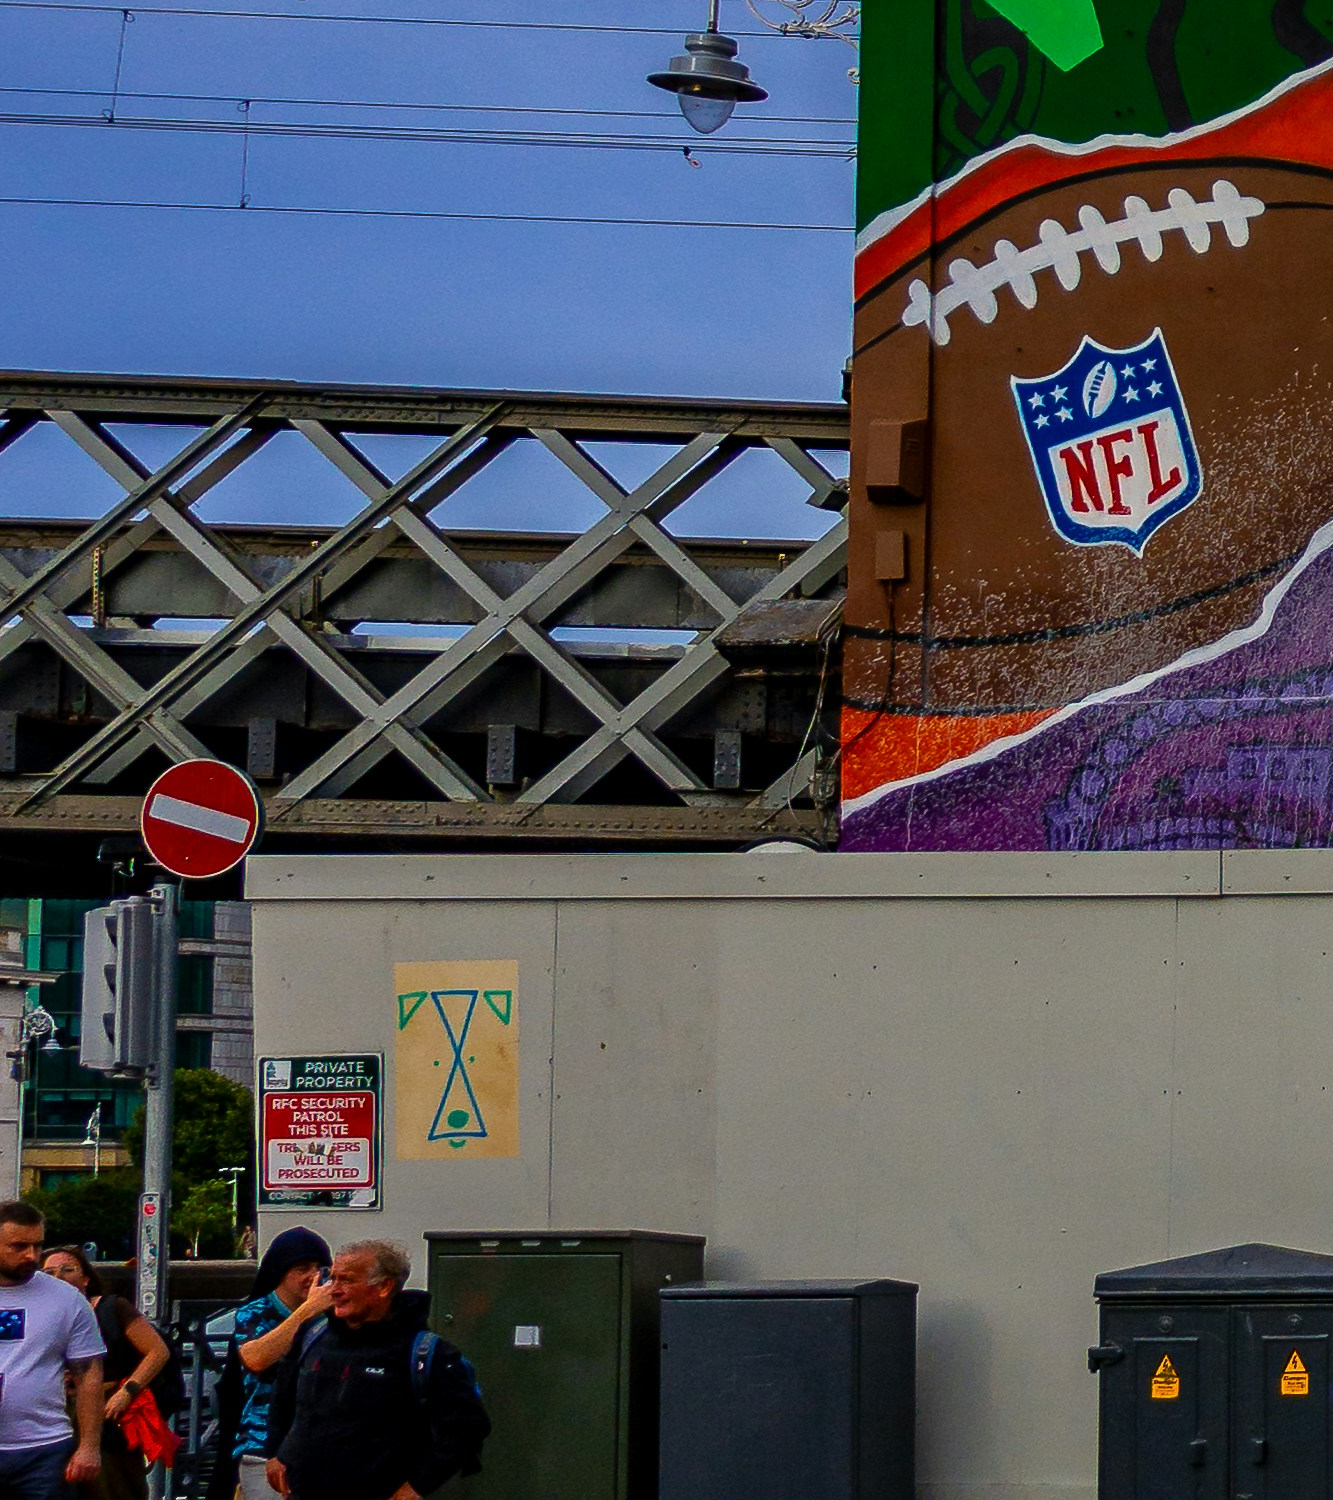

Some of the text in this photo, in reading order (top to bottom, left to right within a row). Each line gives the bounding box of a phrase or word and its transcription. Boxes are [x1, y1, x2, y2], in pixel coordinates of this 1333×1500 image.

[1059, 420, 1182, 518] NFL
[304, 1061, 365, 1074] PRIVATE
[295, 1076, 374, 1088] PROPERTY
[272, 1097, 366, 1110] RFC SECURITY
[292, 1111, 344, 1122] PATROL
[288, 1124, 349, 1135] THIS SITE
[294, 1154, 344, 1166] WILL BE
[277, 1168, 360, 1179] PROSECUTED
